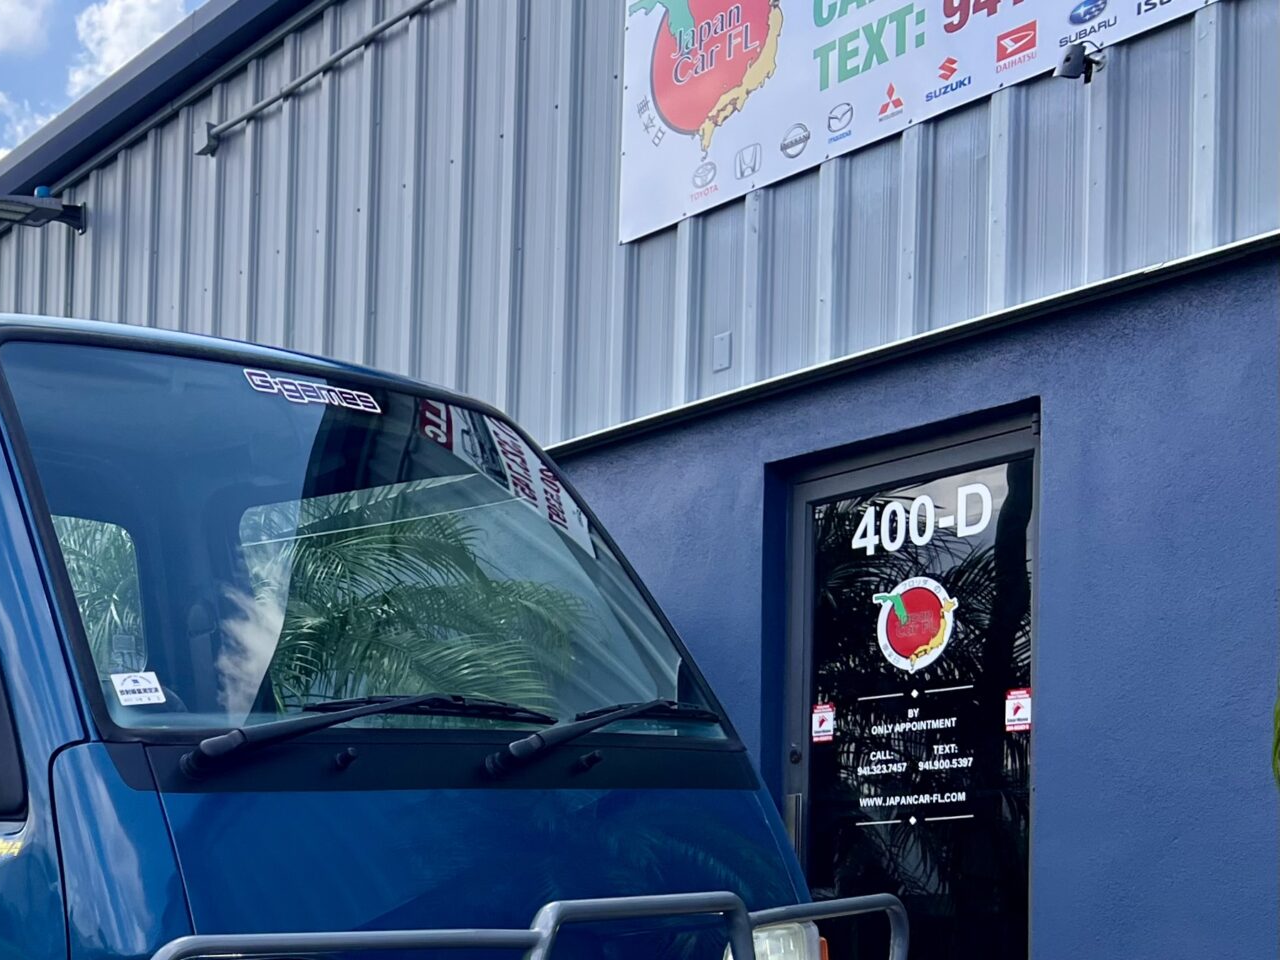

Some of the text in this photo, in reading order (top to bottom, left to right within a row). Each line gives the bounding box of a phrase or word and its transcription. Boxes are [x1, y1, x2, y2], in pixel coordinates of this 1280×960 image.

[672, 3, 741, 59] Japan
[1059, 16, 1117, 48] SUBARU
[673, 23, 760, 84] Car FL
[813, 3, 925, 92] TEXT:
[995, 51, 1037, 74] DAIHATSU
[925, 75, 971, 102] SUZUKI
[690, 185, 719, 202] TOYOTA
[851, 482, 993, 557] 400-D
[907, 708, 920, 718] BY
[871, 717, 957, 735] ONLY APPOINTMENT
[870, 750, 894, 761] CALL:
[933, 744, 958, 754] TEXT:
[857, 762, 907, 776] 941.323.7457
[918, 757, 973, 771] 941.900.5397
[859, 791, 966, 807] WWW.JAPANCAR-FL.COM
